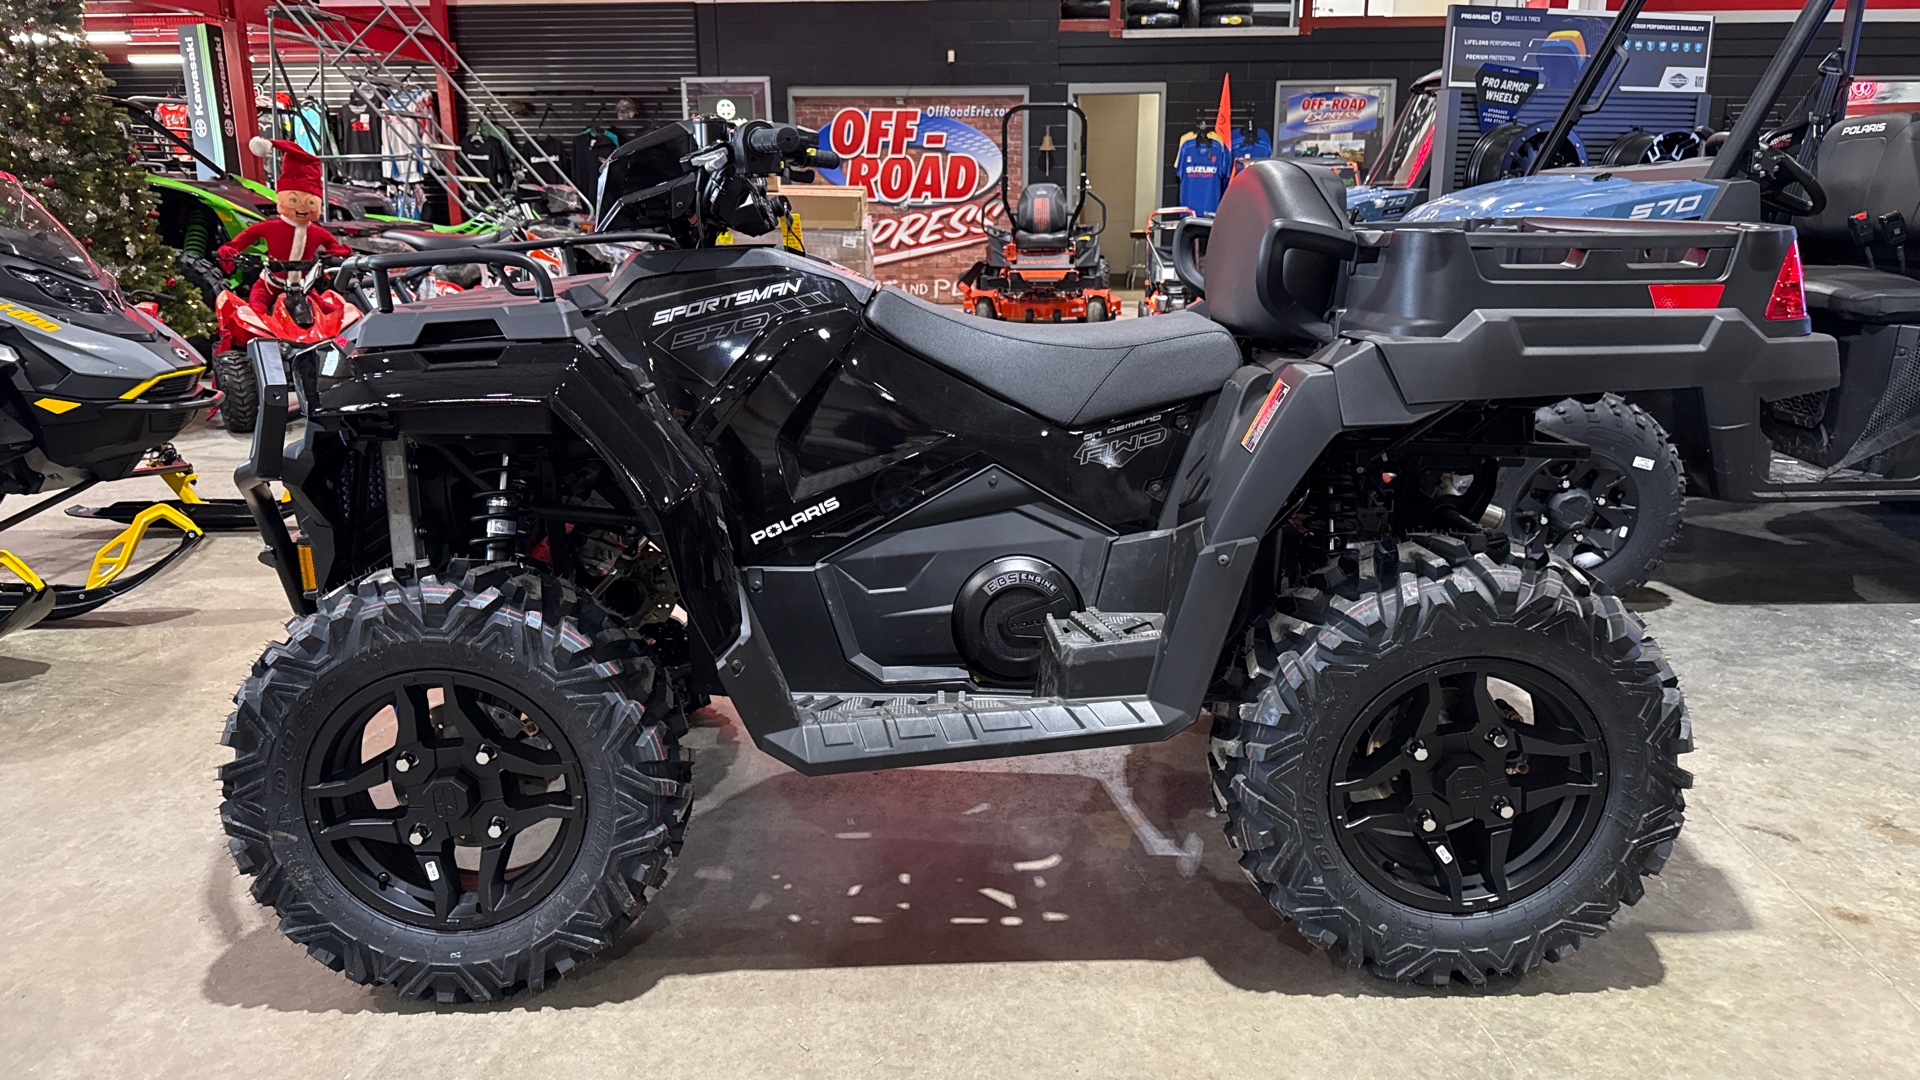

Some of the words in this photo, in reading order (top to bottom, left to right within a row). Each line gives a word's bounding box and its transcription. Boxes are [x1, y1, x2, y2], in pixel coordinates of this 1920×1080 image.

[185, 36, 204, 116] Kawasaki
[213, 36, 232, 116] Kawasaki
[1481, 76, 1501, 88] PRO
[1500, 79, 1531, 93] ARMOR
[1485, 89, 1520, 105] WHEELS
[1841, 122, 1887, 136] POLARIS
[846, 153, 979, 202] ROAD
[1186, 165, 1218, 174] SUZUKI
[1628, 194, 1703, 219] 570
[872, 199, 1005, 250] PRESS
[652, 277, 803, 327] SPORTSMAN
[934, 278, 965, 298] PL
[671, 312, 770, 351] 570
[1107, 414, 1162, 434] DEMAND
[1080, 427, 1167, 466] AWD
[750, 496, 840, 545] POLARIS
[987, 573, 1018, 594] EBS
[1020, 573, 1057, 593] ENGINE
